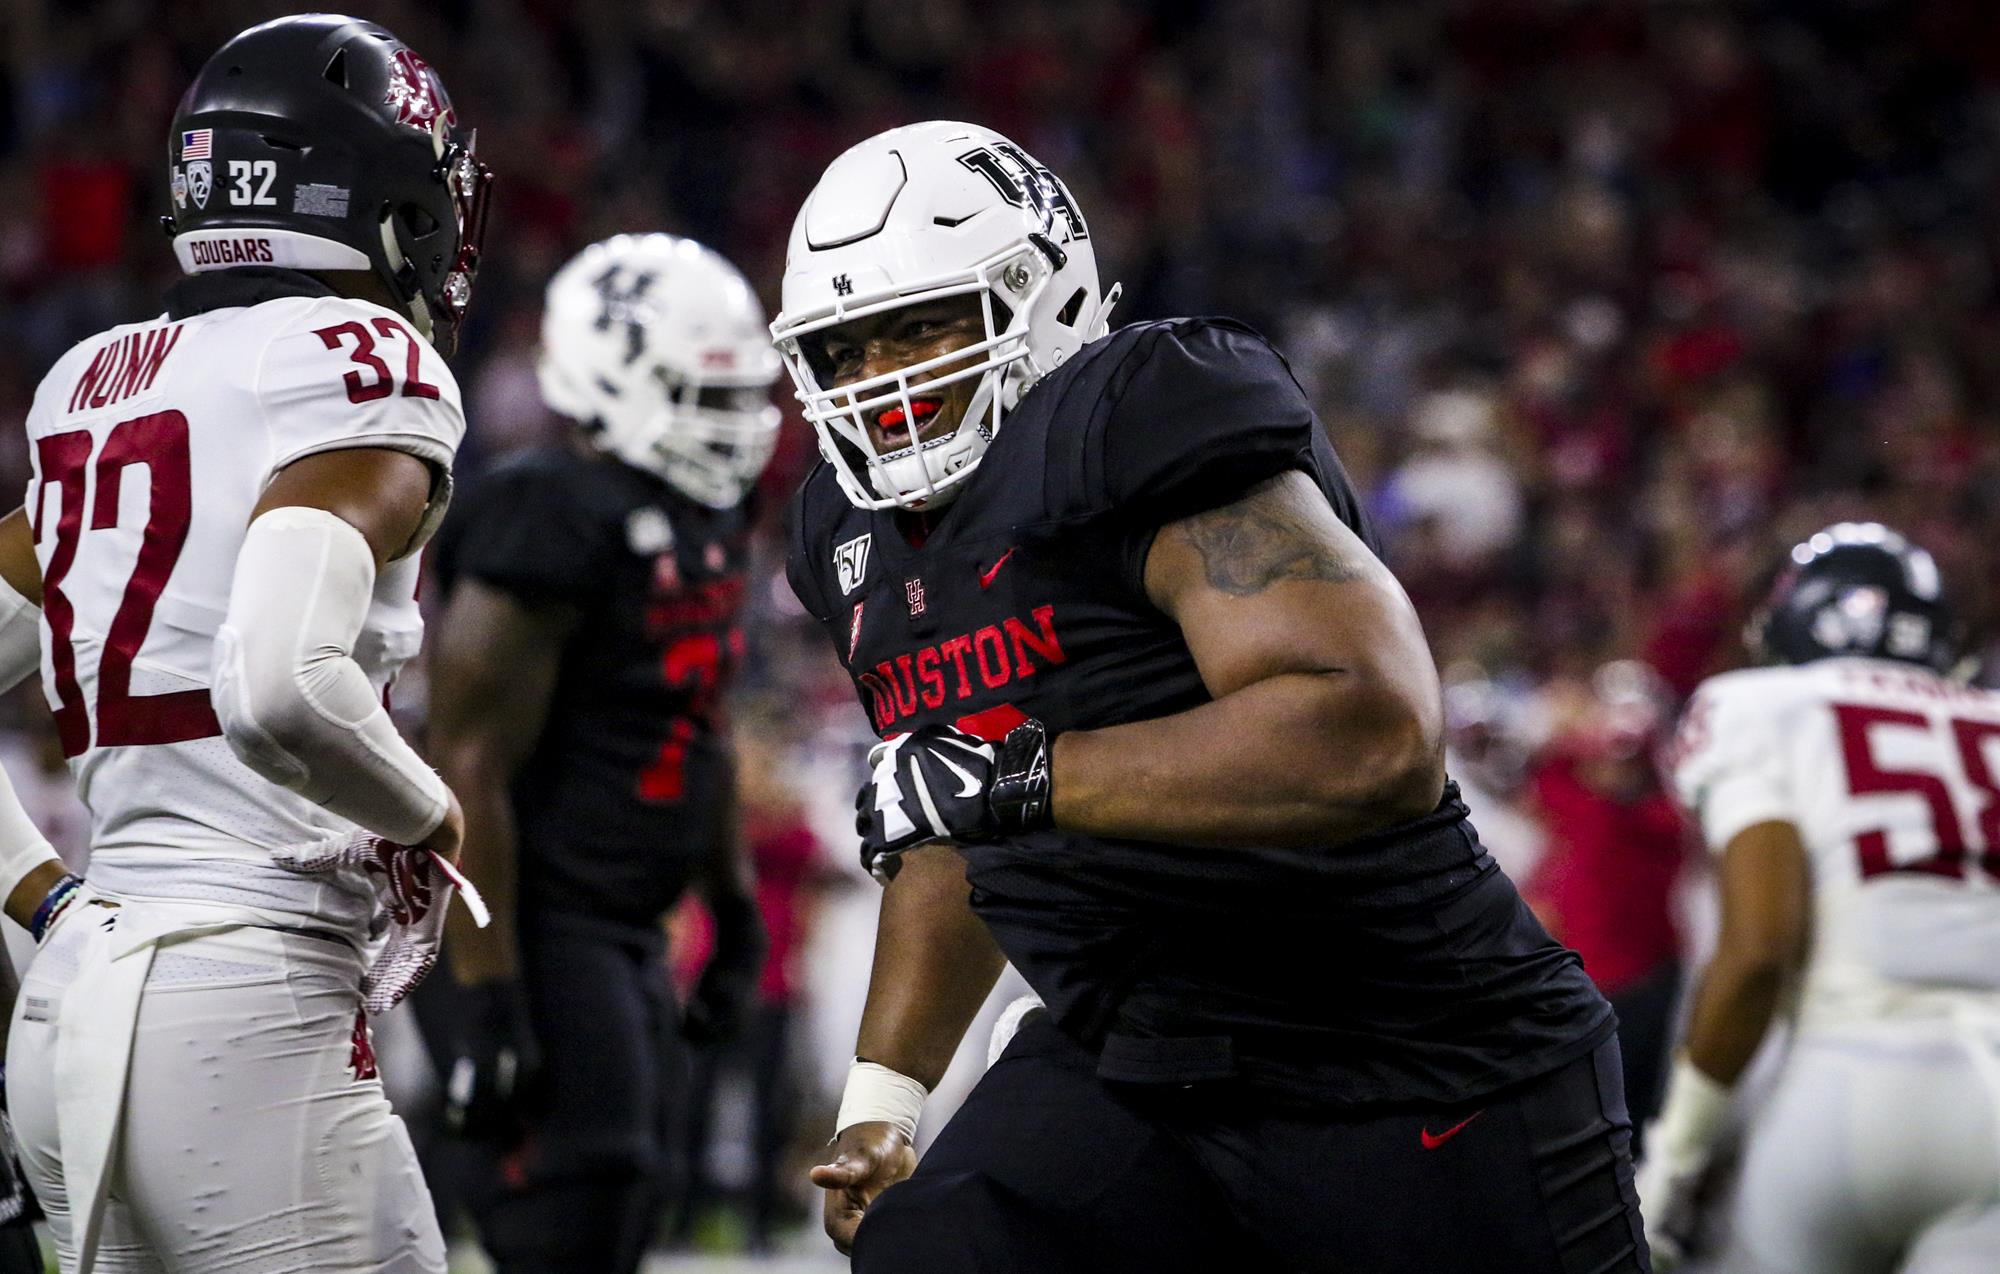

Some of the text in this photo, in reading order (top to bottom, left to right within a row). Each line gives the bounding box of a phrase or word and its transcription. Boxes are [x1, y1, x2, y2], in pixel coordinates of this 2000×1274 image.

[228, 160, 277, 206] 32
[189, 238, 274, 266] COUGARS
[68, 324, 184, 415] NUNN
[313, 317, 441, 405] 32
[33, 409, 225, 760] 32
[858, 603, 1067, 731] OUSTON
